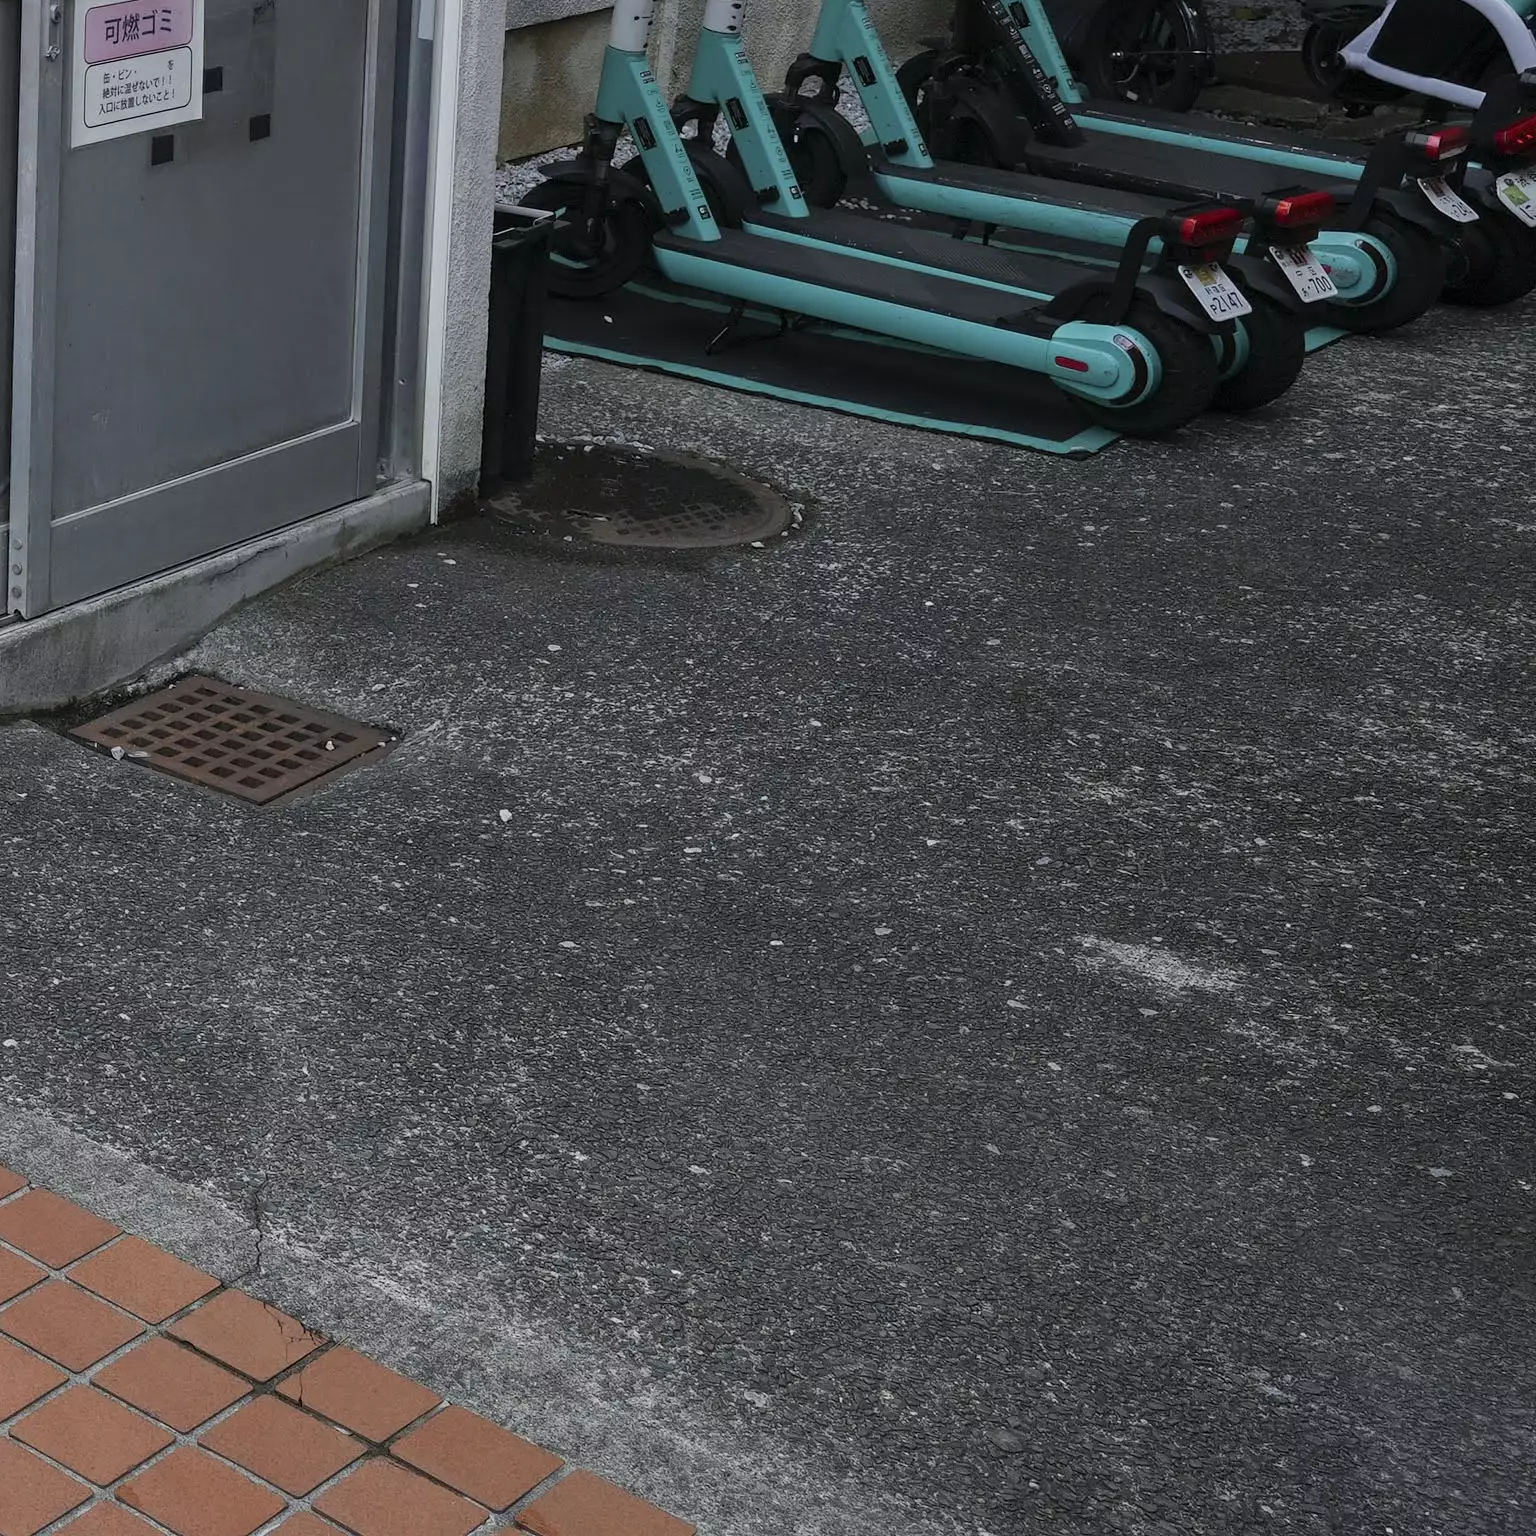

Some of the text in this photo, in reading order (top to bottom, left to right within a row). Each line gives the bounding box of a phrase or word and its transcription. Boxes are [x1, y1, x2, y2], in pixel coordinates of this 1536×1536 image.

[104, 9, 172, 45] 可燃ゴミ
[102, 74, 173, 100] 絶対に混ぜないで！！
[99, 88, 175, 116] 入口に放置しないこと！
